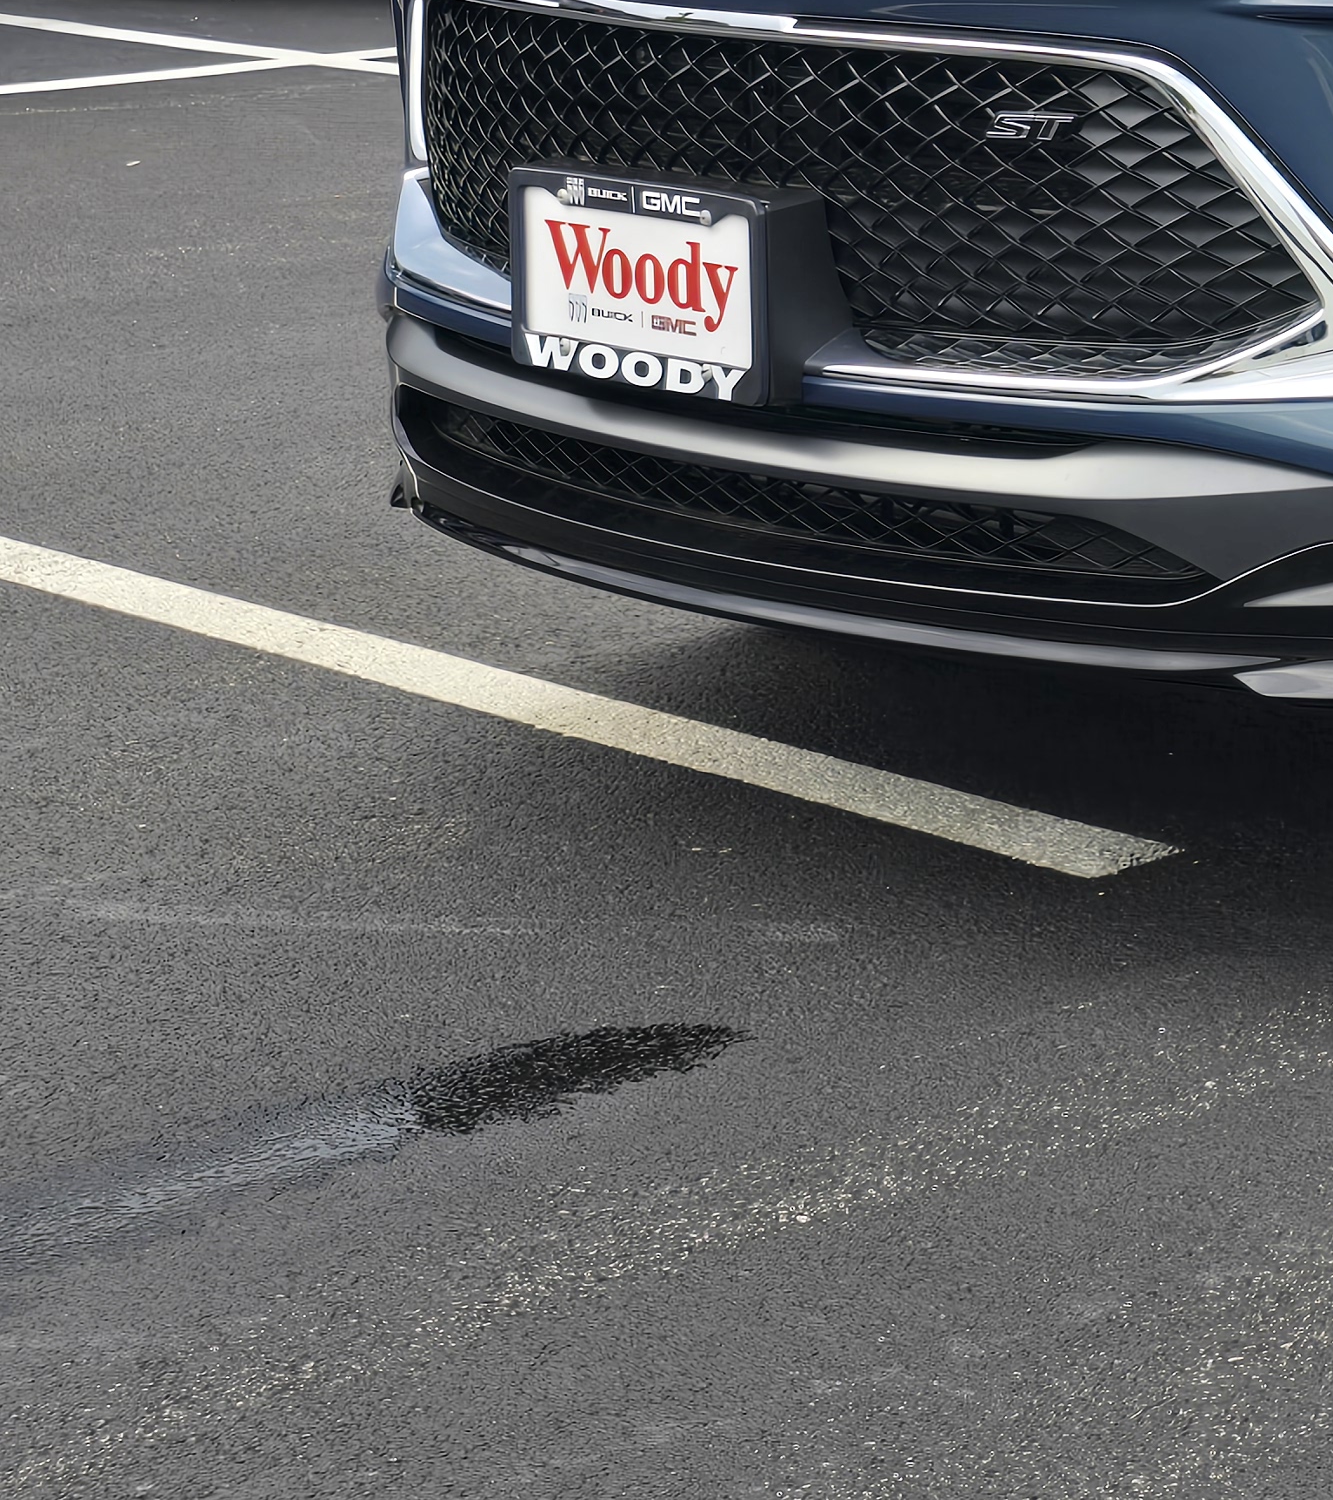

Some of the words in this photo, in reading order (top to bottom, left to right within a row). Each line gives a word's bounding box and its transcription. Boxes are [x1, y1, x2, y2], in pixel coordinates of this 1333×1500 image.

[986, 111, 1077, 141] ST
[587, 186, 628, 202] BUICK
[641, 190, 703, 217] GMC
[544, 218, 739, 332] Woody
[591, 307, 634, 323] BUICK
[651, 314, 697, 337] GMC
[524, 332, 750, 402] WOODY
